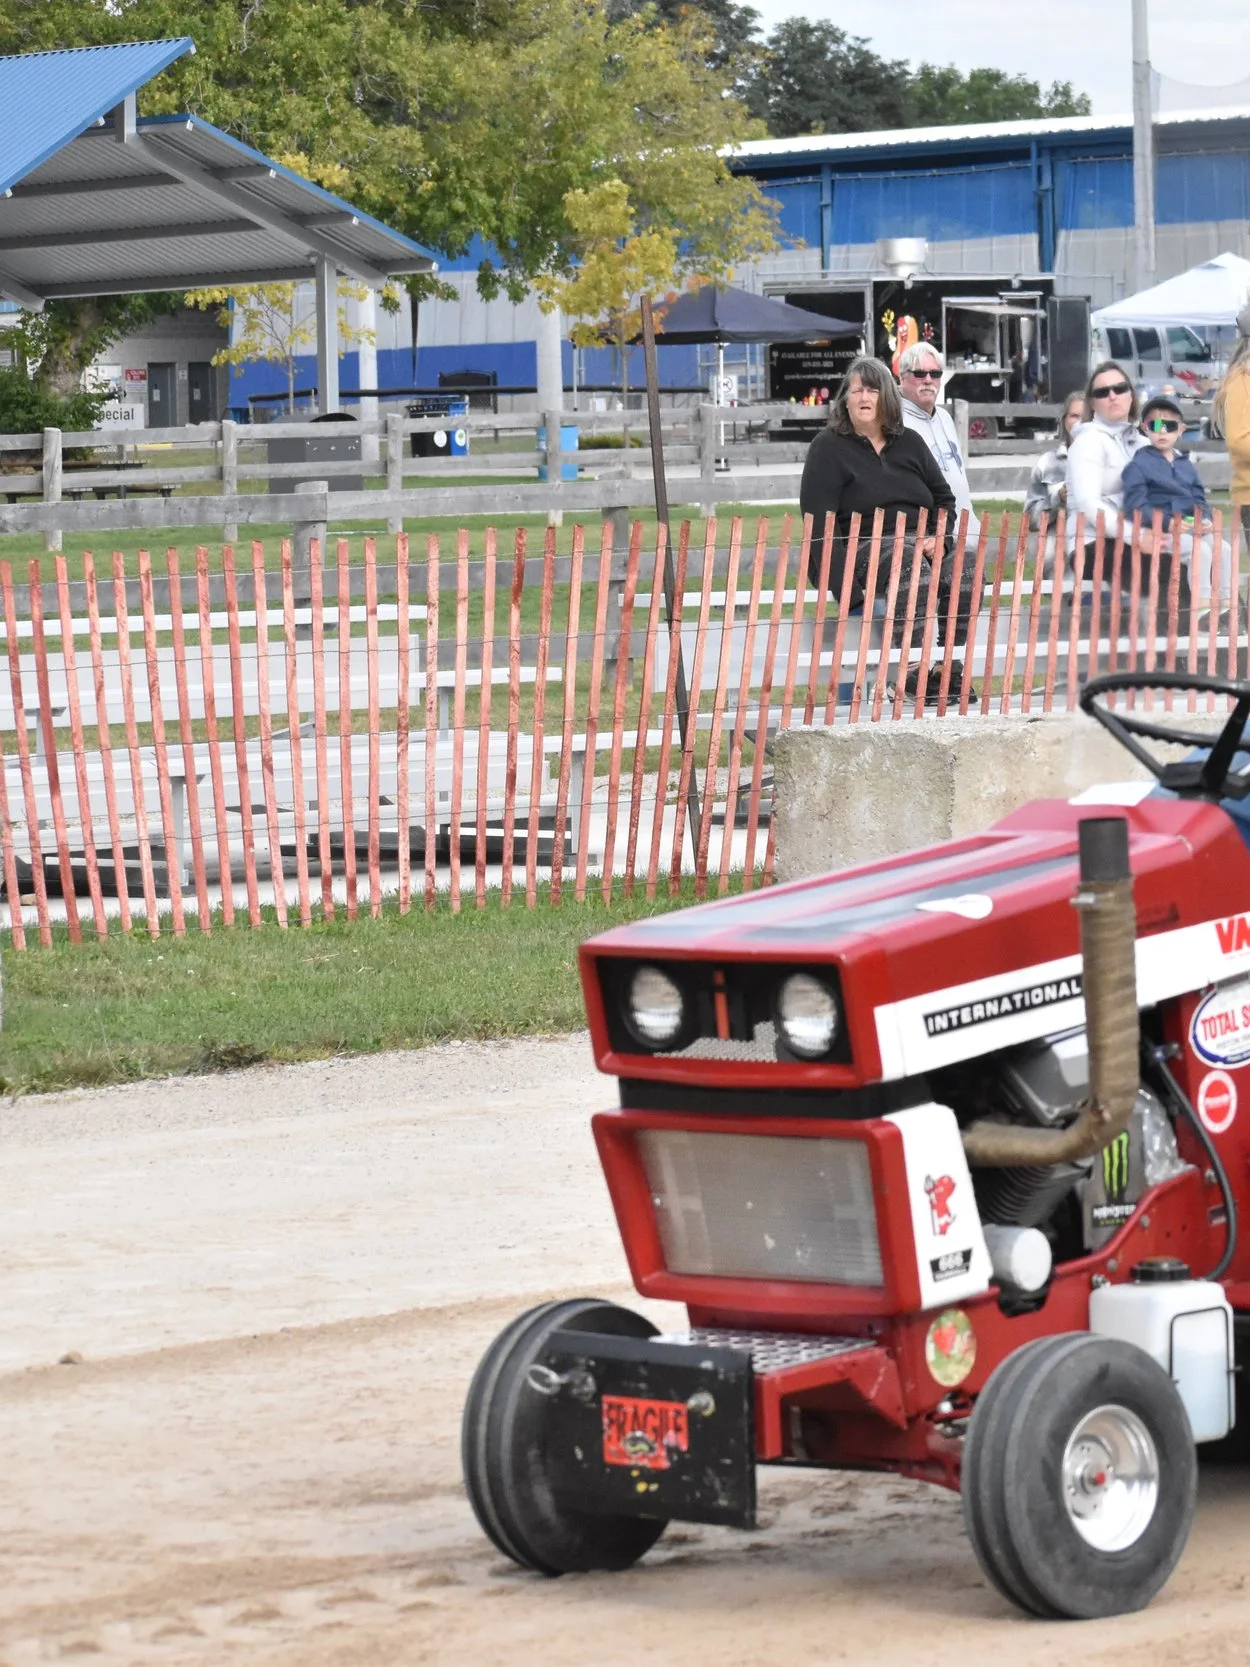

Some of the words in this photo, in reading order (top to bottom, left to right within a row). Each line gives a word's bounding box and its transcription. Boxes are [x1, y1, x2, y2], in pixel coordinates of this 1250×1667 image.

[99, 407, 135, 423] pecial
[927, 978, 1083, 1034] INTERNATIONAL
[1201, 1008, 1240, 1041] TOTAL
